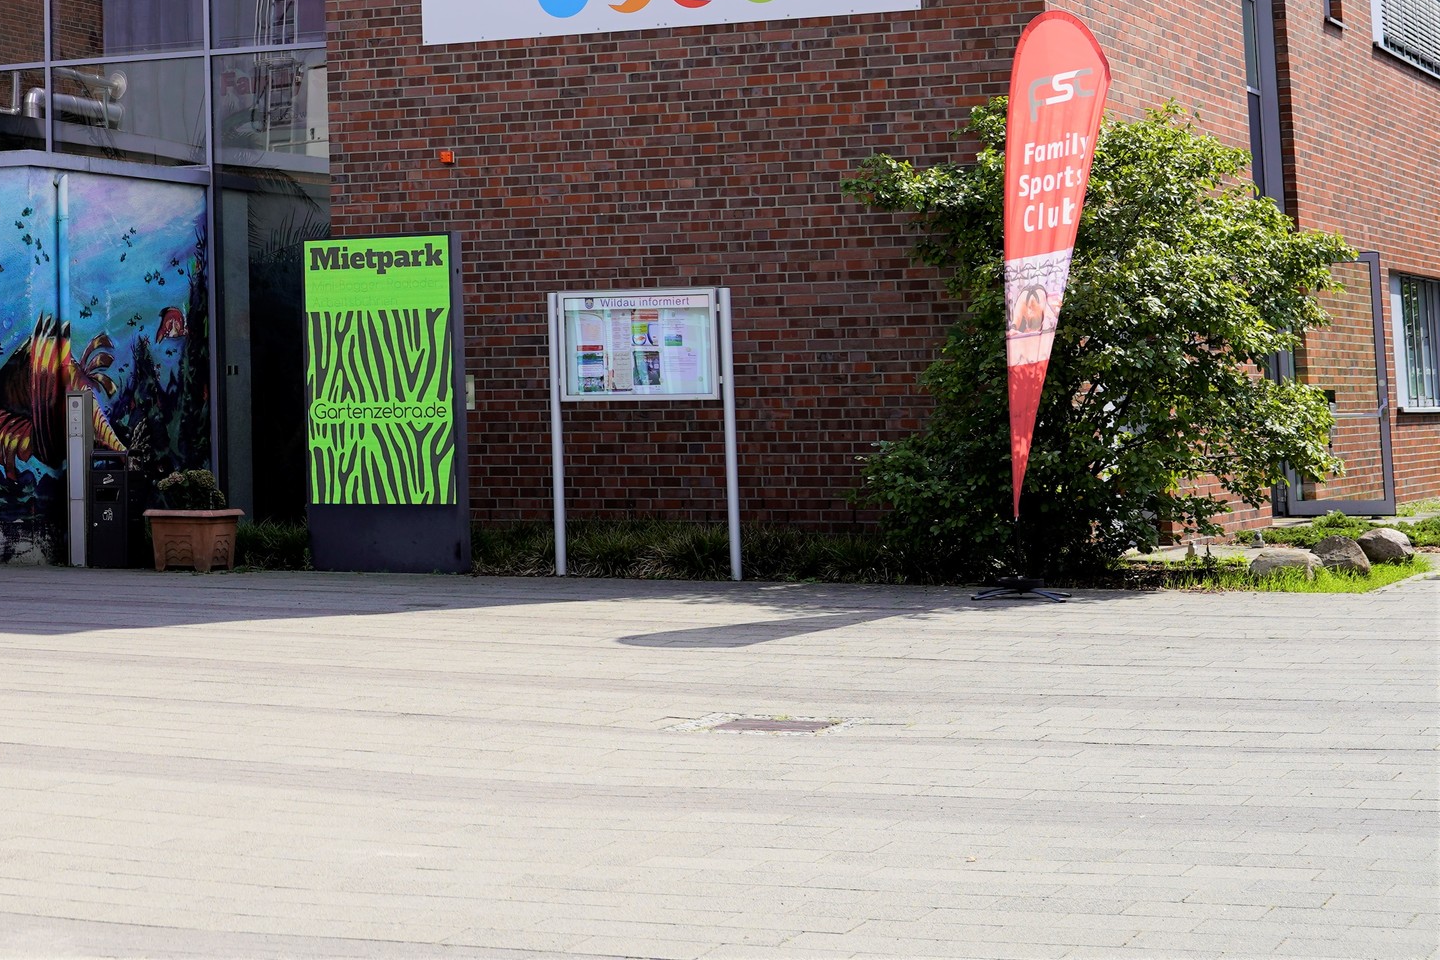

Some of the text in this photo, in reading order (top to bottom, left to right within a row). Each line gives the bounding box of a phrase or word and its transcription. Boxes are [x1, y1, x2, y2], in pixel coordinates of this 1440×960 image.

[1028, 68, 1095, 123] FSC
[1024, 132, 1090, 165] Family
[1018, 165, 1083, 200] Sports
[310, 243, 443, 274] Mietpark
[600, 296, 690, 307] Wildau informiert
[314, 402, 447, 419] Gartenzebra.de
